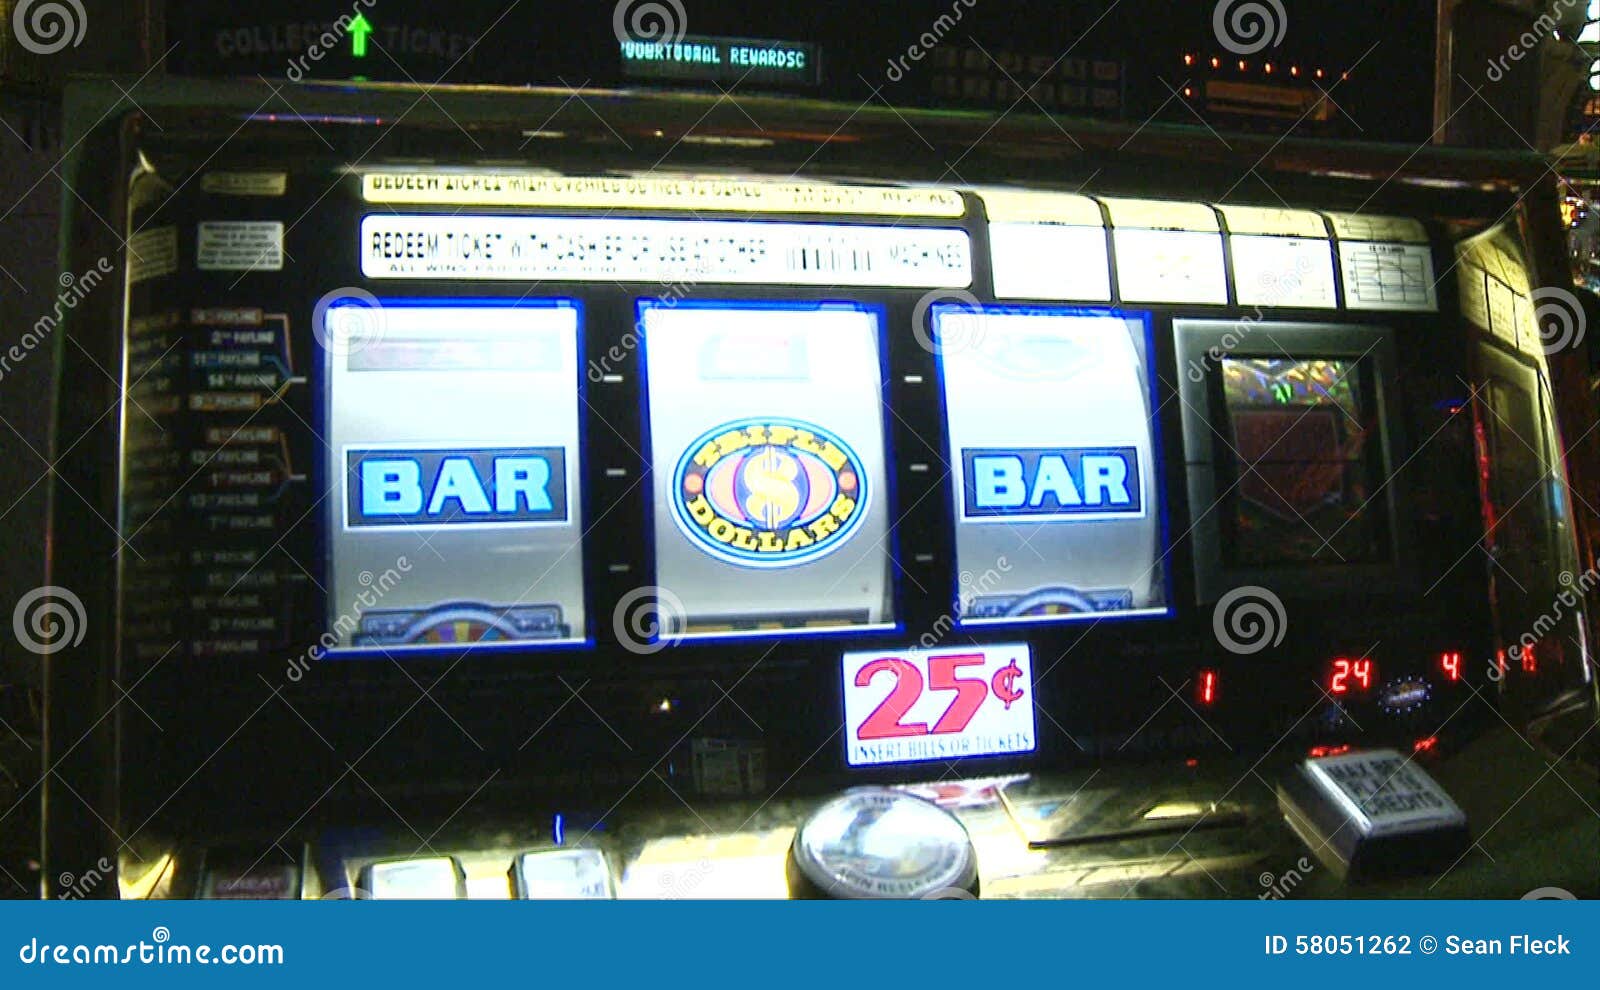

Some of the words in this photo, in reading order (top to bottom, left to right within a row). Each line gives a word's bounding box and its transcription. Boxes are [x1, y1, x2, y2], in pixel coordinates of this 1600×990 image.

[372, 231, 438, 259] REDEEM
[359, 455, 554, 517] BAR
[971, 453, 1132, 510] BAR
[686, 493, 856, 553] DOLLARS
[1331, 657, 1372, 693] 24
[1441, 651, 1460, 682] 4
[854, 651, 1024, 740] 25¢
[1202, 670, 1214, 703] 1
[854, 743, 902, 762] INSERT
[909, 740, 946, 759] BILLS
[951, 736, 970, 753] OR
[976, 732, 1031, 752] TICKETS
